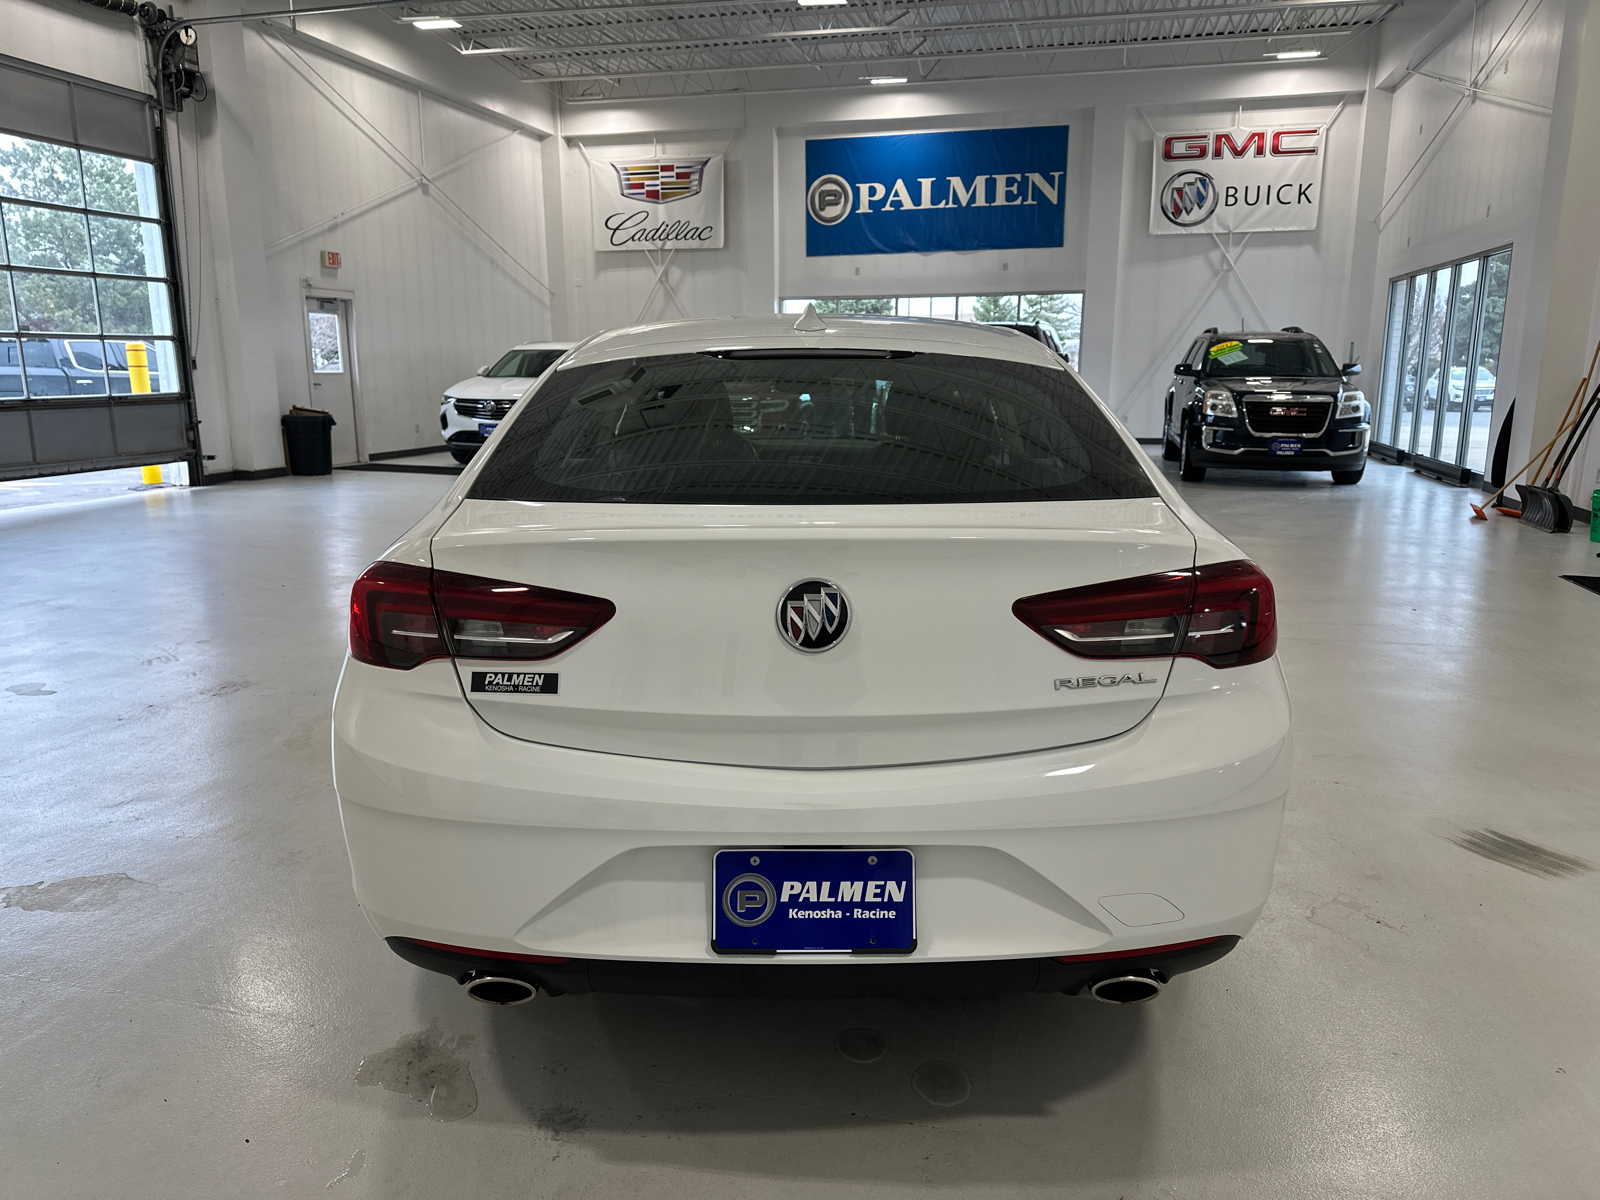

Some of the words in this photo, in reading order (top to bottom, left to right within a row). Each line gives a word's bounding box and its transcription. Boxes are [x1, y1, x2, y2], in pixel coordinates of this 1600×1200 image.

[1162, 127, 1320, 162] GMC
[855, 171, 1064, 213] PALMEN
[1224, 183, 1314, 207] BUICK
[604, 210, 713, 246] Cadillac
[1270, 407, 1307, 416] GMC
[484, 673, 544, 686] PALMEN
[1053, 673, 1158, 691] REGAL
[780, 881, 907, 902] PALMEN
[788, 908, 842, 919] Kenosha
[853, 908, 896, 919] Racine
